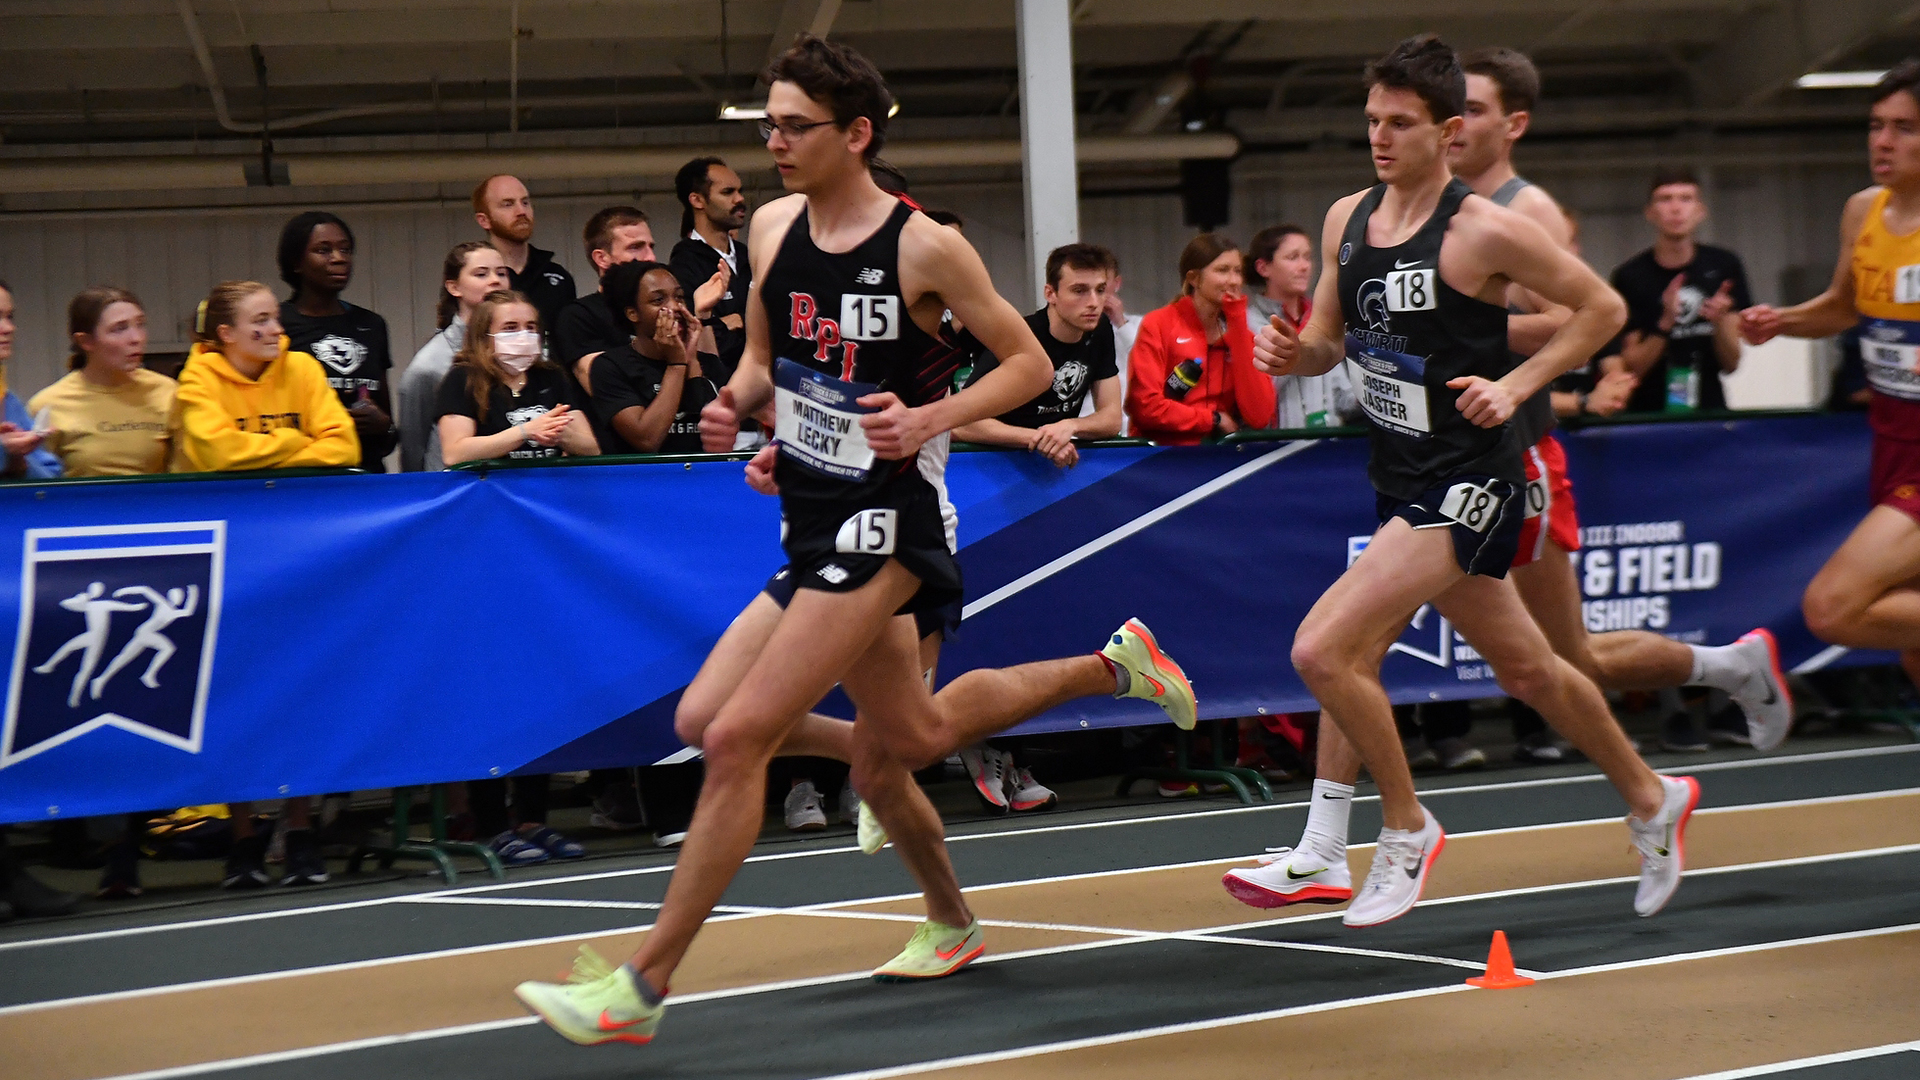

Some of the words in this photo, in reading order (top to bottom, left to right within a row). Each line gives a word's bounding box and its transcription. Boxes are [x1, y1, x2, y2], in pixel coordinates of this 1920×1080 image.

[1394, 272, 1426, 309] 18
[850, 298, 888, 338] 15
[788, 291, 859, 384] RPI
[1353, 328, 1408, 354] CWRU
[1362, 373, 1401, 399] JOSEPH
[793, 399, 852, 435] MATTHEW
[1362, 389, 1408, 421] JASTER
[797, 422, 842, 457] LECKY
[1456, 486, 1490, 527] 18
[850, 512, 886, 551] 15
[1583, 525, 1614, 547] III
[1614, 520, 1684, 546] INDOOR
[1584, 549, 1614, 598] &
[1618, 541, 1722, 595] FIELD
